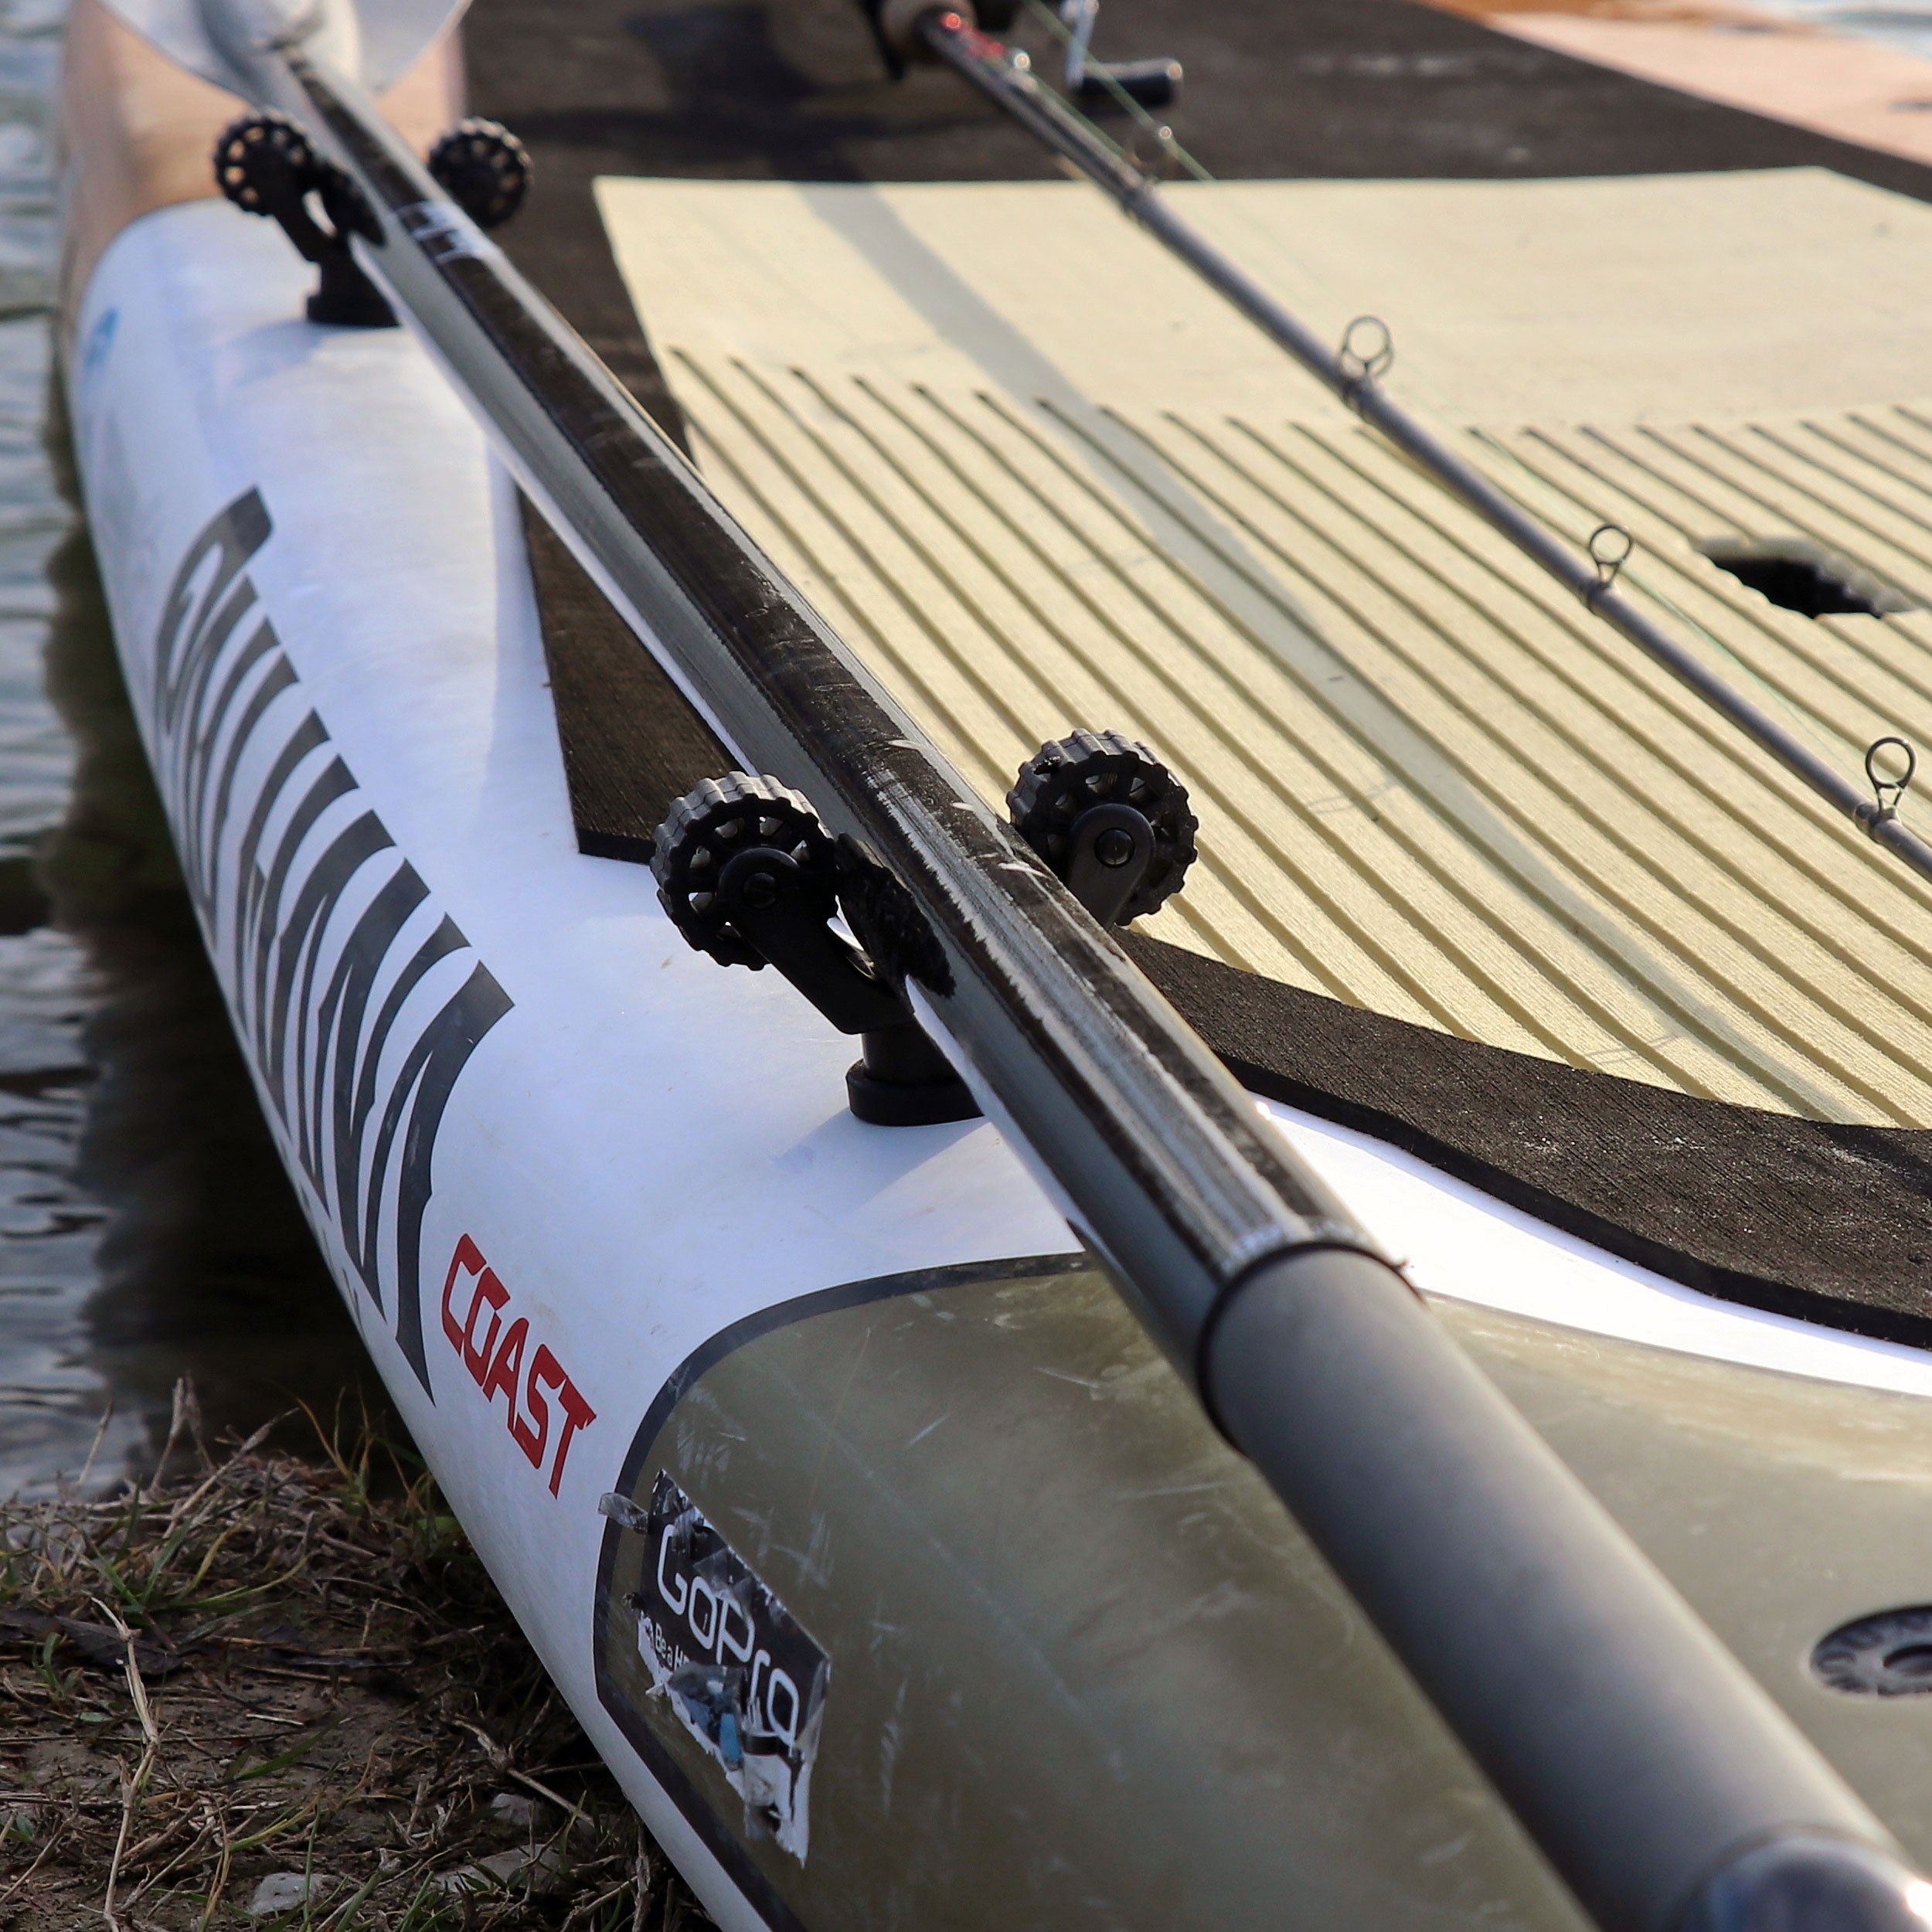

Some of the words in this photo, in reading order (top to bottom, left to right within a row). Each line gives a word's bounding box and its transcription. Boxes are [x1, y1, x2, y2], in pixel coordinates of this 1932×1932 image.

[441, 1233, 597, 1498] COAST
[655, 1622, 667, 1658] Be
[667, 1645, 673, 1668] a
